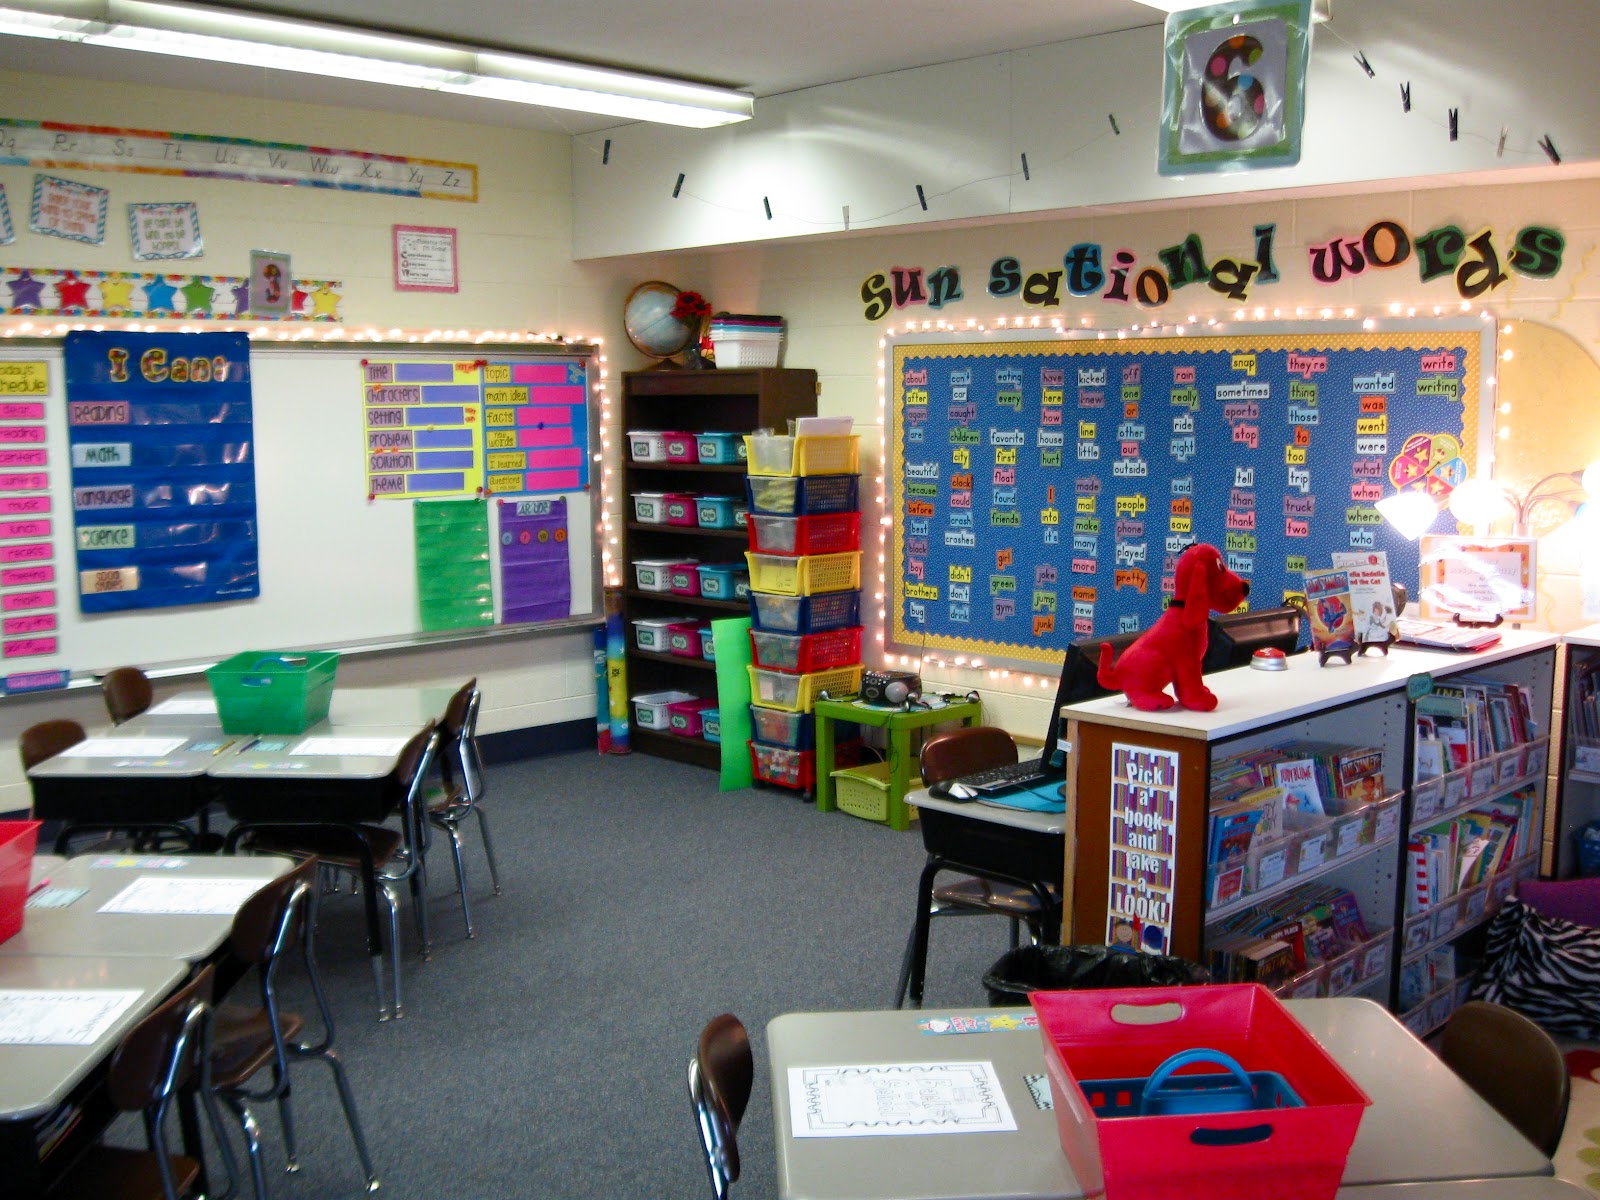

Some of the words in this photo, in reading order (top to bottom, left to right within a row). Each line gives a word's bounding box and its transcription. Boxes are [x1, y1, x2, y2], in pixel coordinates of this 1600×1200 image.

[1201, 34, 1266, 142] 6
[0, 129, 16, 156] q
[108, 348, 129, 382] I
[1233, 359, 1255, 371] snap
[1289, 357, 1325, 375] they're
[1422, 356, 1454, 369] write
[906, 373, 927, 383] about
[997, 371, 1022, 385] eating
[1043, 371, 1062, 381] have
[1079, 371, 1105, 384] kicked
[1123, 367, 1139, 380] off
[1176, 370, 1194, 379] rain
[1354, 379, 1394, 390] wanted
[1417, 380, 1457, 397] writing
[486, 392, 507, 402] main
[510, 390, 527, 402] idea
[907, 391, 927, 403] after
[953, 391, 966, 399] car
[1043, 391, 1062, 403] here
[1123, 389, 1139, 398] one
[1217, 385, 1268, 398] sometimes
[1291, 385, 1316, 403] thing
[998, 394, 1021, 406] every
[1172, 390, 1197, 407] really
[1126, 407, 1136, 416] or
[1362, 401, 1384, 410] was
[487, 412, 513, 423] facts
[908, 411, 927, 422] again
[949, 408, 975, 422] caught
[1043, 412, 1060, 422] how
[1225, 405, 1258, 421] sports
[1290, 410, 1318, 422] those
[1174, 418, 1192, 430] ride
[1358, 420, 1385, 432] went
[950, 428, 979, 442] children
[1080, 424, 1094, 437] line
[1119, 427, 1144, 438] other
[1234, 428, 1257, 444] stop
[1296, 430, 1307, 443] to
[991, 432, 1023, 443] favorite
[1039, 433, 1063, 444] house
[1078, 445, 1098, 458] little
[1122, 446, 1137, 454] our
[1172, 440, 1194, 456] right
[1358, 442, 1386, 452] were
[953, 451, 968, 464] city
[997, 451, 1016, 462] first
[1042, 454, 1060, 465] hurt
[1287, 449, 1304, 461] too
[906, 464, 938, 477] beautiful
[1114, 461, 1145, 474] outside
[1354, 463, 1381, 475] what
[951, 475, 971, 487] clock
[994, 471, 1014, 483] float
[1236, 472, 1252, 484] tell
[1290, 474, 1309, 488] trip
[907, 483, 936, 495] because
[1076, 480, 1099, 491] made
[1173, 482, 1191, 492] said
[994, 492, 1016, 504] found
[1353, 486, 1380, 499] when
[951, 494, 970, 506] could
[1078, 499, 1093, 511] mail
[1232, 493, 1253, 505] than
[907, 502, 933, 515] before
[1117, 498, 1145, 513] people
[1172, 500, 1190, 512] sale
[1285, 500, 1312, 512] truck
[951, 514, 971, 525] crash
[991, 512, 1019, 524] friends
[1042, 511, 1058, 523] into
[1228, 514, 1254, 527] thank
[1347, 508, 1381, 523] where
[911, 523, 928, 533] best
[1075, 519, 1098, 531] make
[1117, 523, 1142, 536] phone
[1171, 521, 1190, 530] saw
[1287, 522, 1307, 535] two
[946, 533, 974, 545] crashes
[1045, 531, 1058, 542] it's
[1227, 536, 1254, 549] that's
[1351, 532, 1373, 545] who
[1074, 539, 1096, 553] many
[998, 553, 1011, 567] girl
[1117, 547, 1145, 562] played
[1073, 562, 1095, 572] more
[1229, 559, 1251, 571] their
[1287, 561, 1304, 570] use
[950, 567, 970, 581] didn't
[1037, 568, 1055, 582] joke
[1116, 572, 1145, 588] pretty
[991, 580, 1014, 591] green
[950, 588, 968, 600] don't
[1073, 590, 1095, 600] name
[1034, 594, 1055, 608] jump
[911, 605, 924, 619] bug
[950, 609, 969, 620] drink
[996, 603, 1013, 616] gym
[1075, 606, 1092, 615] new
[1034, 618, 1052, 631] junk
[1075, 621, 1092, 631] nice
[1121, 618, 1138, 631] quit
[1126, 762, 1163, 786] Pick
[1139, 790, 1148, 806] a
[1124, 806, 1163, 831] book
[1128, 832, 1157, 852] and
[1125, 851, 1160, 873] take
[1137, 877, 1146, 892] a
[1115, 892, 1166, 923] LOOK!
